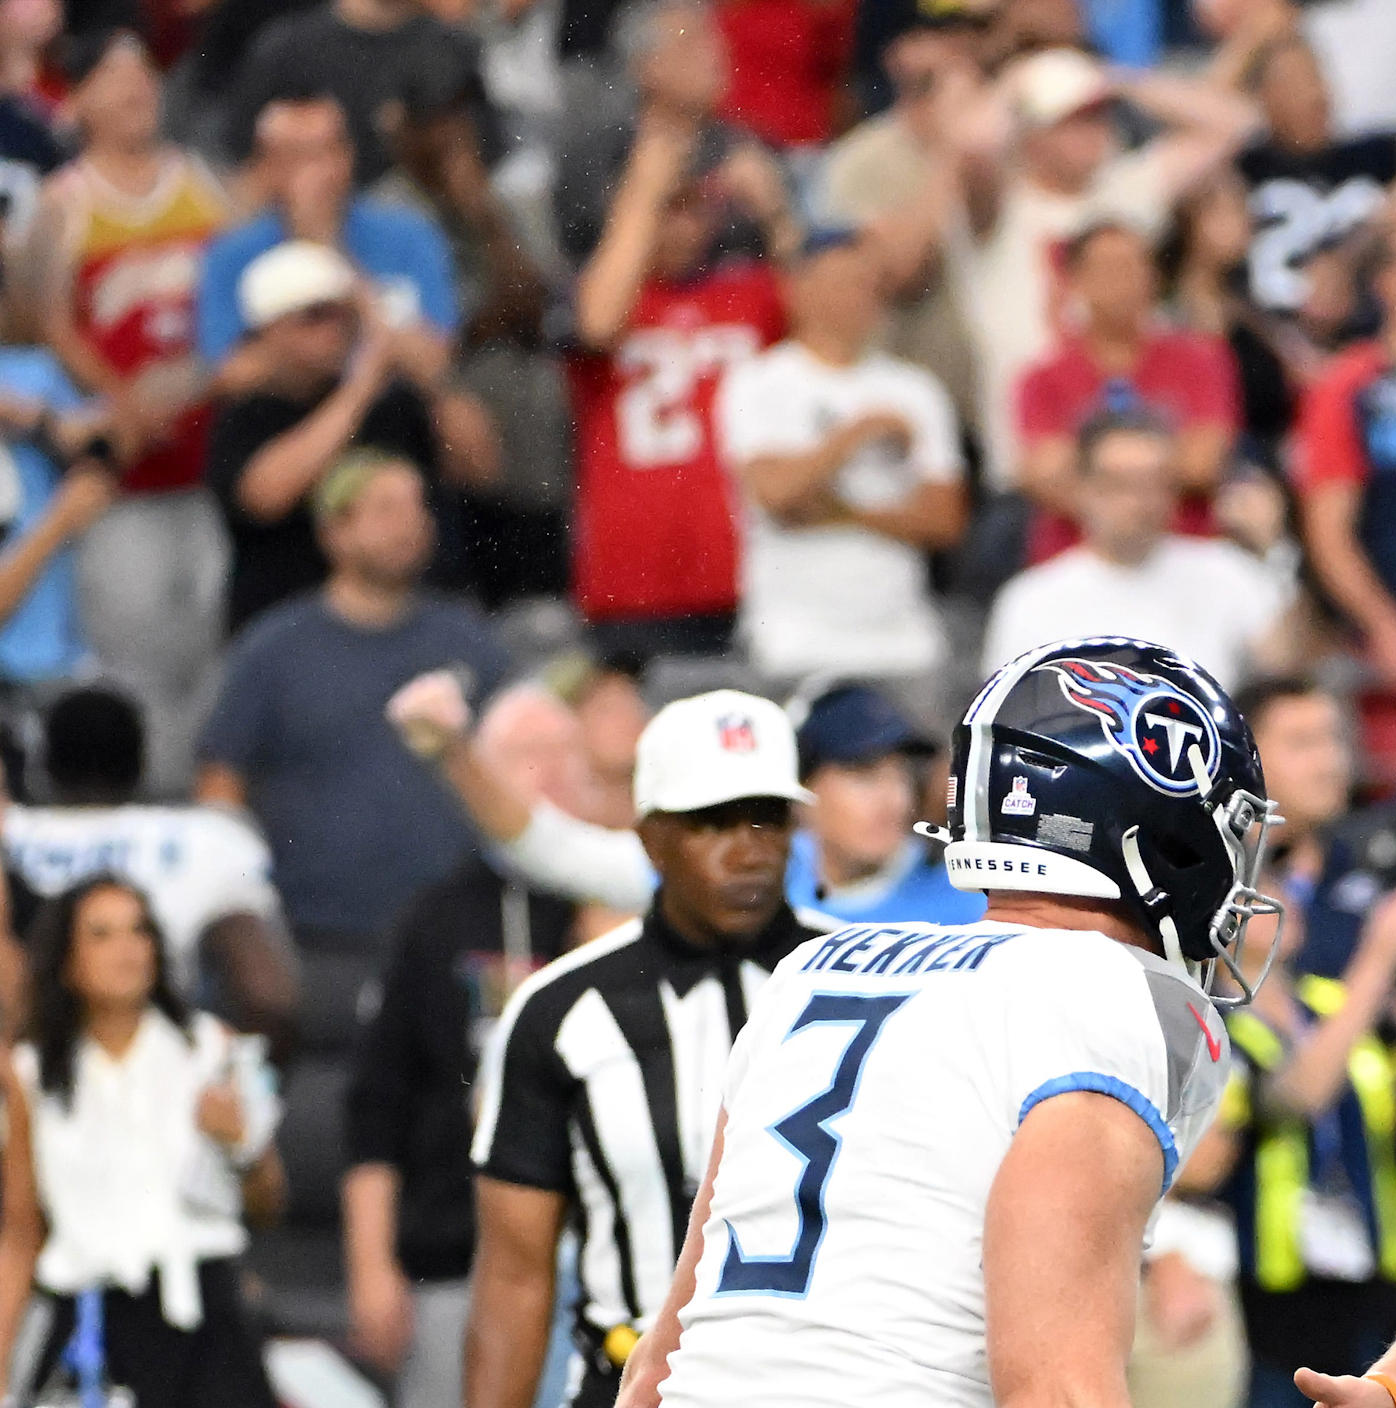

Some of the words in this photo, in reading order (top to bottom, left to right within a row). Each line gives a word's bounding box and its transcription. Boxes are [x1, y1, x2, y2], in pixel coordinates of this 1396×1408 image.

[1004, 798, 1034, 809] CATCH
[949, 857, 1047, 876] ENNESSEE
[798, 926, 1022, 977] HEKKER
[708, 988, 922, 1300] 3
